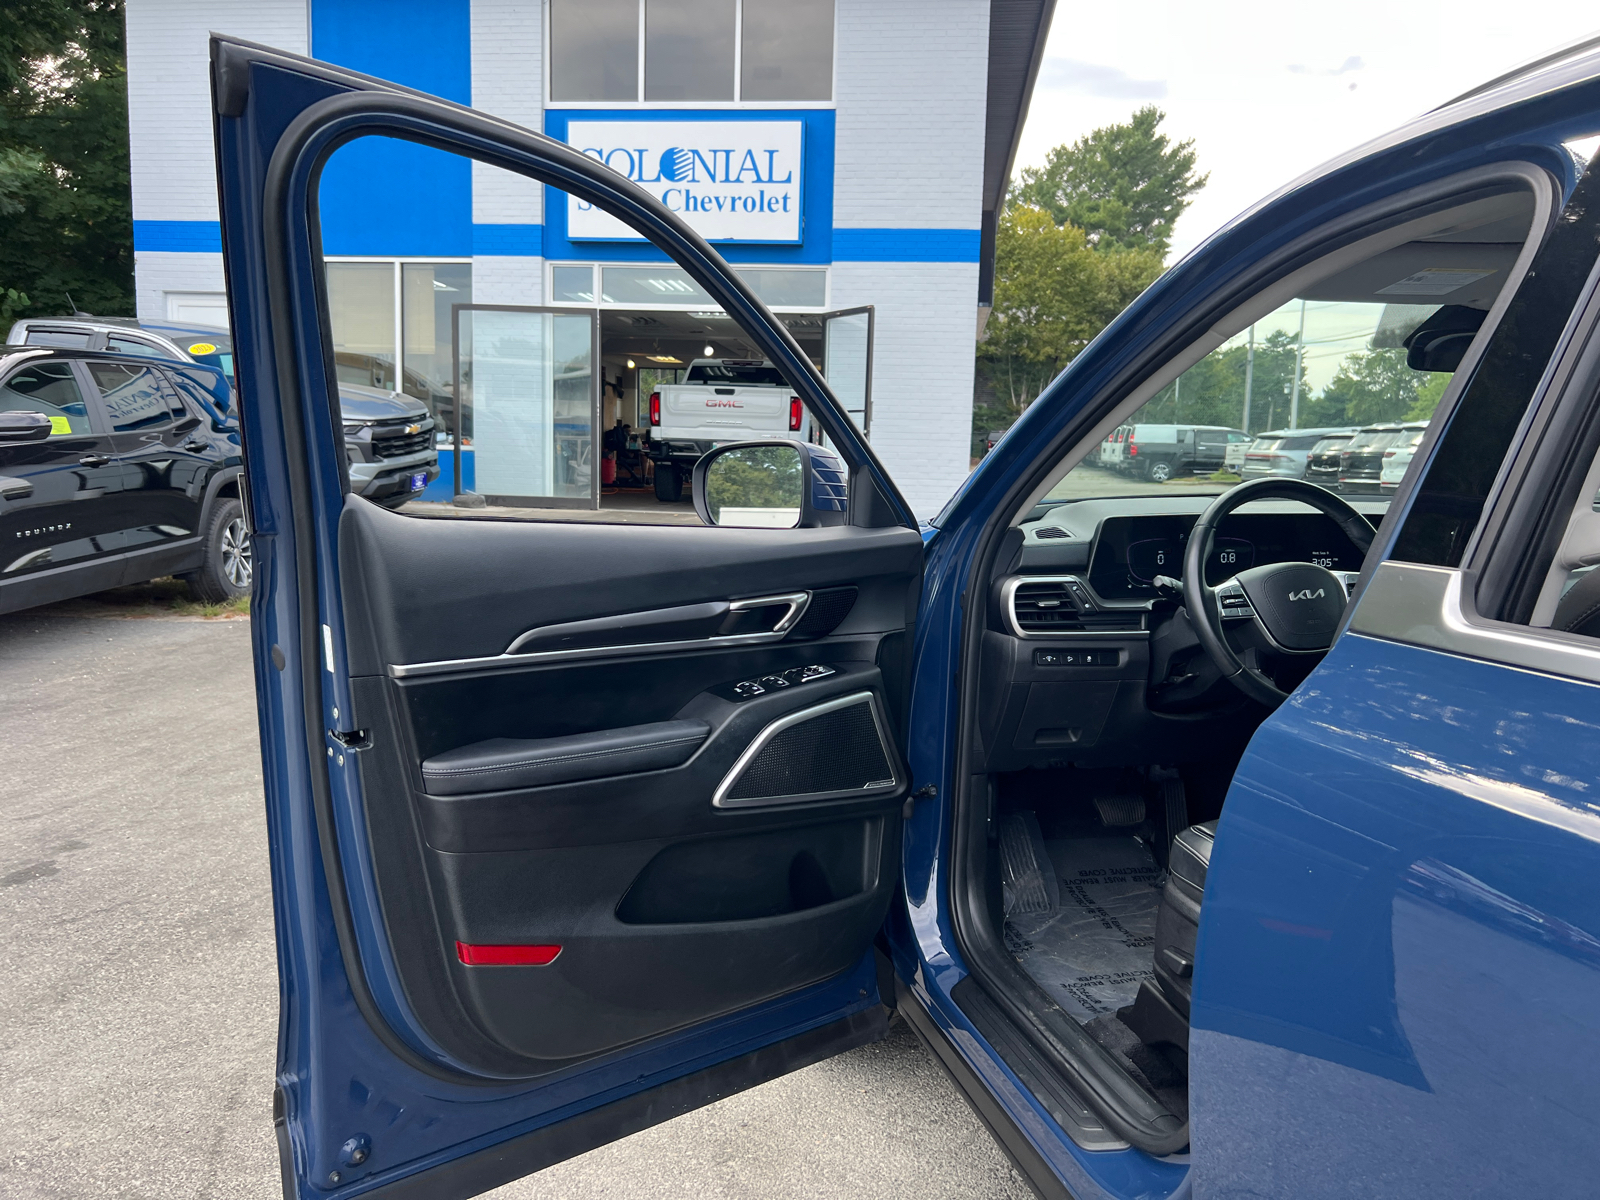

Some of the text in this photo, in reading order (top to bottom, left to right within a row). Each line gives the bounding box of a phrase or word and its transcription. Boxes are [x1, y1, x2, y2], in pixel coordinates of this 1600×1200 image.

[662, 188, 791, 213] Chevrolet
[706, 399, 744, 409] GMC
[16, 522, 72, 538] EQUINOX
[1221, 553, 1236, 563] 0.8
[1312, 558, 1332, 567] 3:05
[1289, 588, 1325, 601] KIA
[1063, 878, 1099, 886] REMOVE
[1103, 876, 1127, 884] MUST
[1060, 980, 1104, 989] REMOVE
[1109, 977, 1136, 985] MUST
